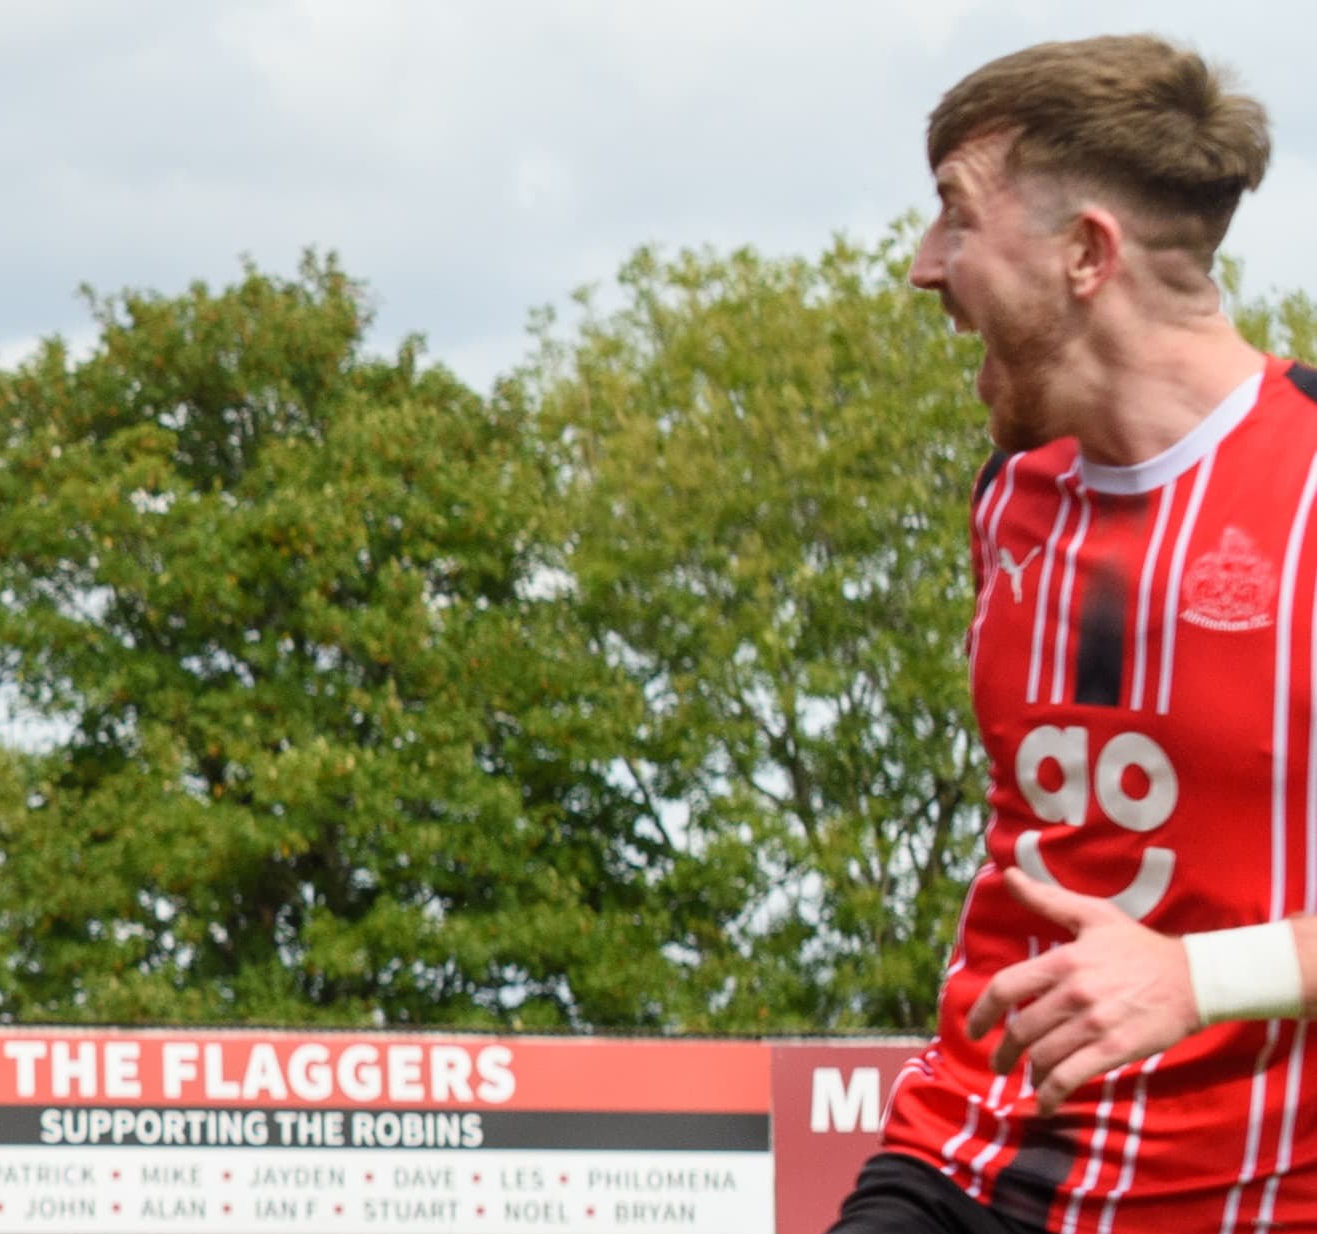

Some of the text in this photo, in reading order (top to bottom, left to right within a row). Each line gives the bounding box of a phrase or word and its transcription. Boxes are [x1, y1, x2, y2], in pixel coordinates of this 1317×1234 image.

[3, 1040, 516, 1102] THE FLAGGERS
[40, 1108, 483, 1148] SUPPORTING THE ROBINS
[141, 1165, 203, 1188] MIKE
[249, 1166, 345, 1190] JAYDEN
[393, 1167, 456, 1190] DAVE
[500, 1168, 544, 1191] LES
[588, 1168, 737, 1192] PHILOMENA
[24, 1197, 97, 1219] JOHN
[140, 1198, 207, 1220] ALAN
[255, 1199, 299, 1220] IAN
[305, 1200, 318, 1221] F
[363, 1200, 459, 1222] STUART
[505, 1201, 570, 1223] NOEL
[615, 1202, 696, 1224] BRYAN
